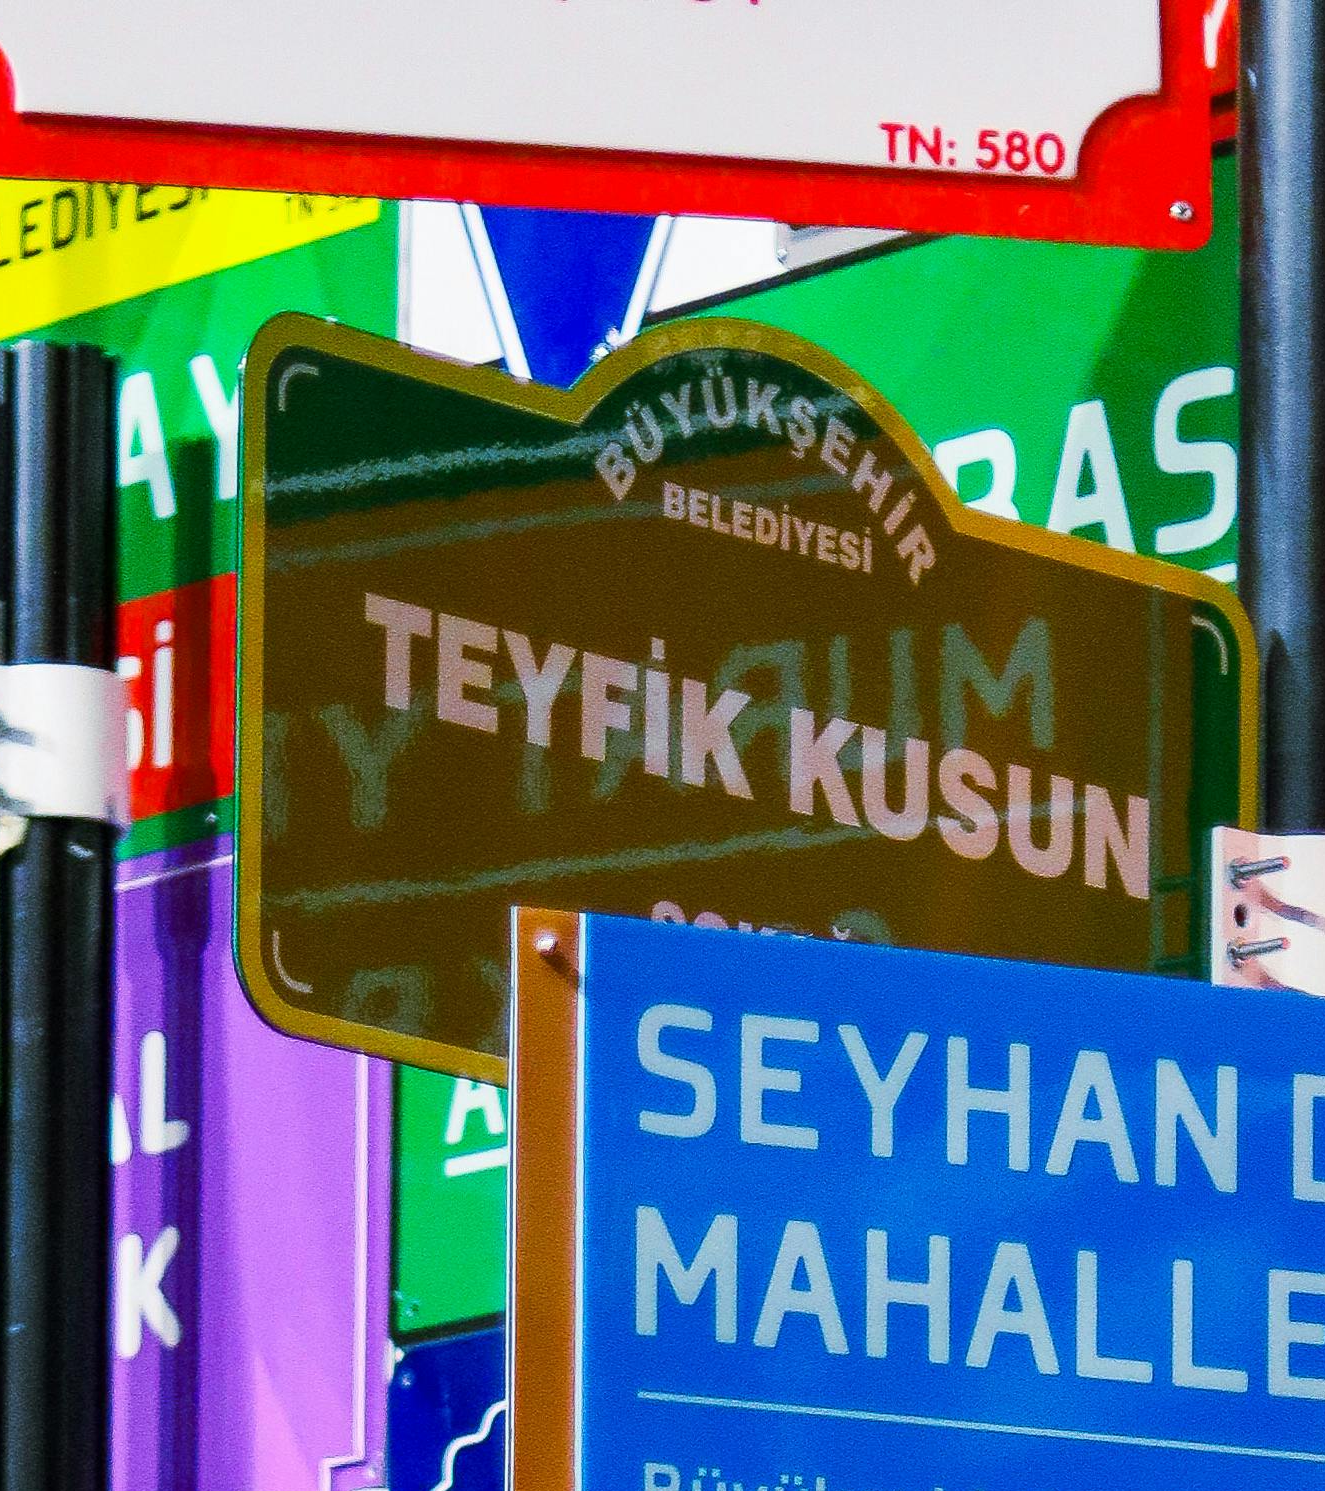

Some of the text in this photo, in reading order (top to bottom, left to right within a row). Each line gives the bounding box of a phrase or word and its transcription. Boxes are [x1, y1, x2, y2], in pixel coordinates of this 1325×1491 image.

[877, 121, 1066, 177] TN: 580
[594, 364, 940, 586] BÜYÜKŞEHİR
[662, 481, 874, 574] BELEDİYESİ
[364, 591, 754, 801] TEYFİK
[787, 706, 1153, 901] KUSUN
[636, 1003, 1240, 1195] SEYHAN
